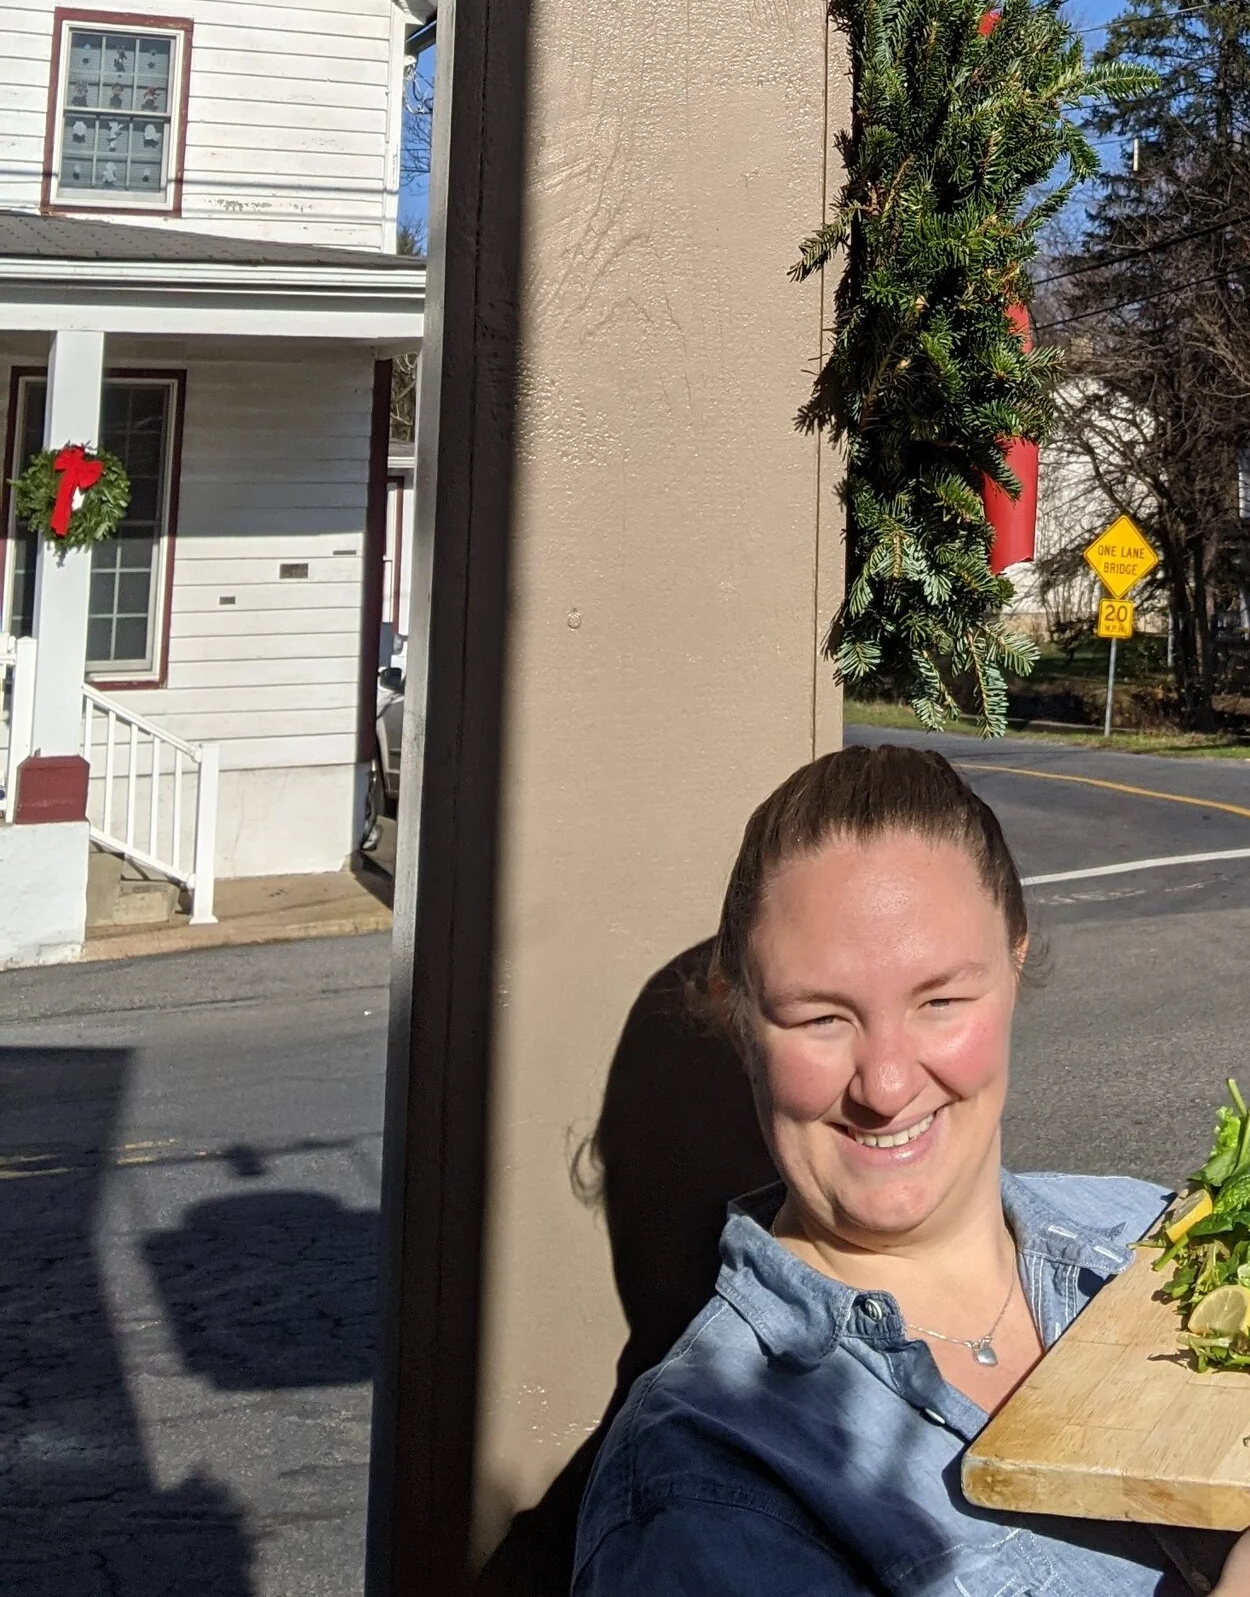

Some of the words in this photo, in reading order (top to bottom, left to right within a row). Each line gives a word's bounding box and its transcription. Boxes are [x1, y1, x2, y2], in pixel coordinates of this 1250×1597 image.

[1098, 544, 1117, 557] ONE
[1121, 546, 1145, 559] LANE
[1103, 561, 1138, 576] BRIDGE
[1104, 604, 1128, 622] 20
